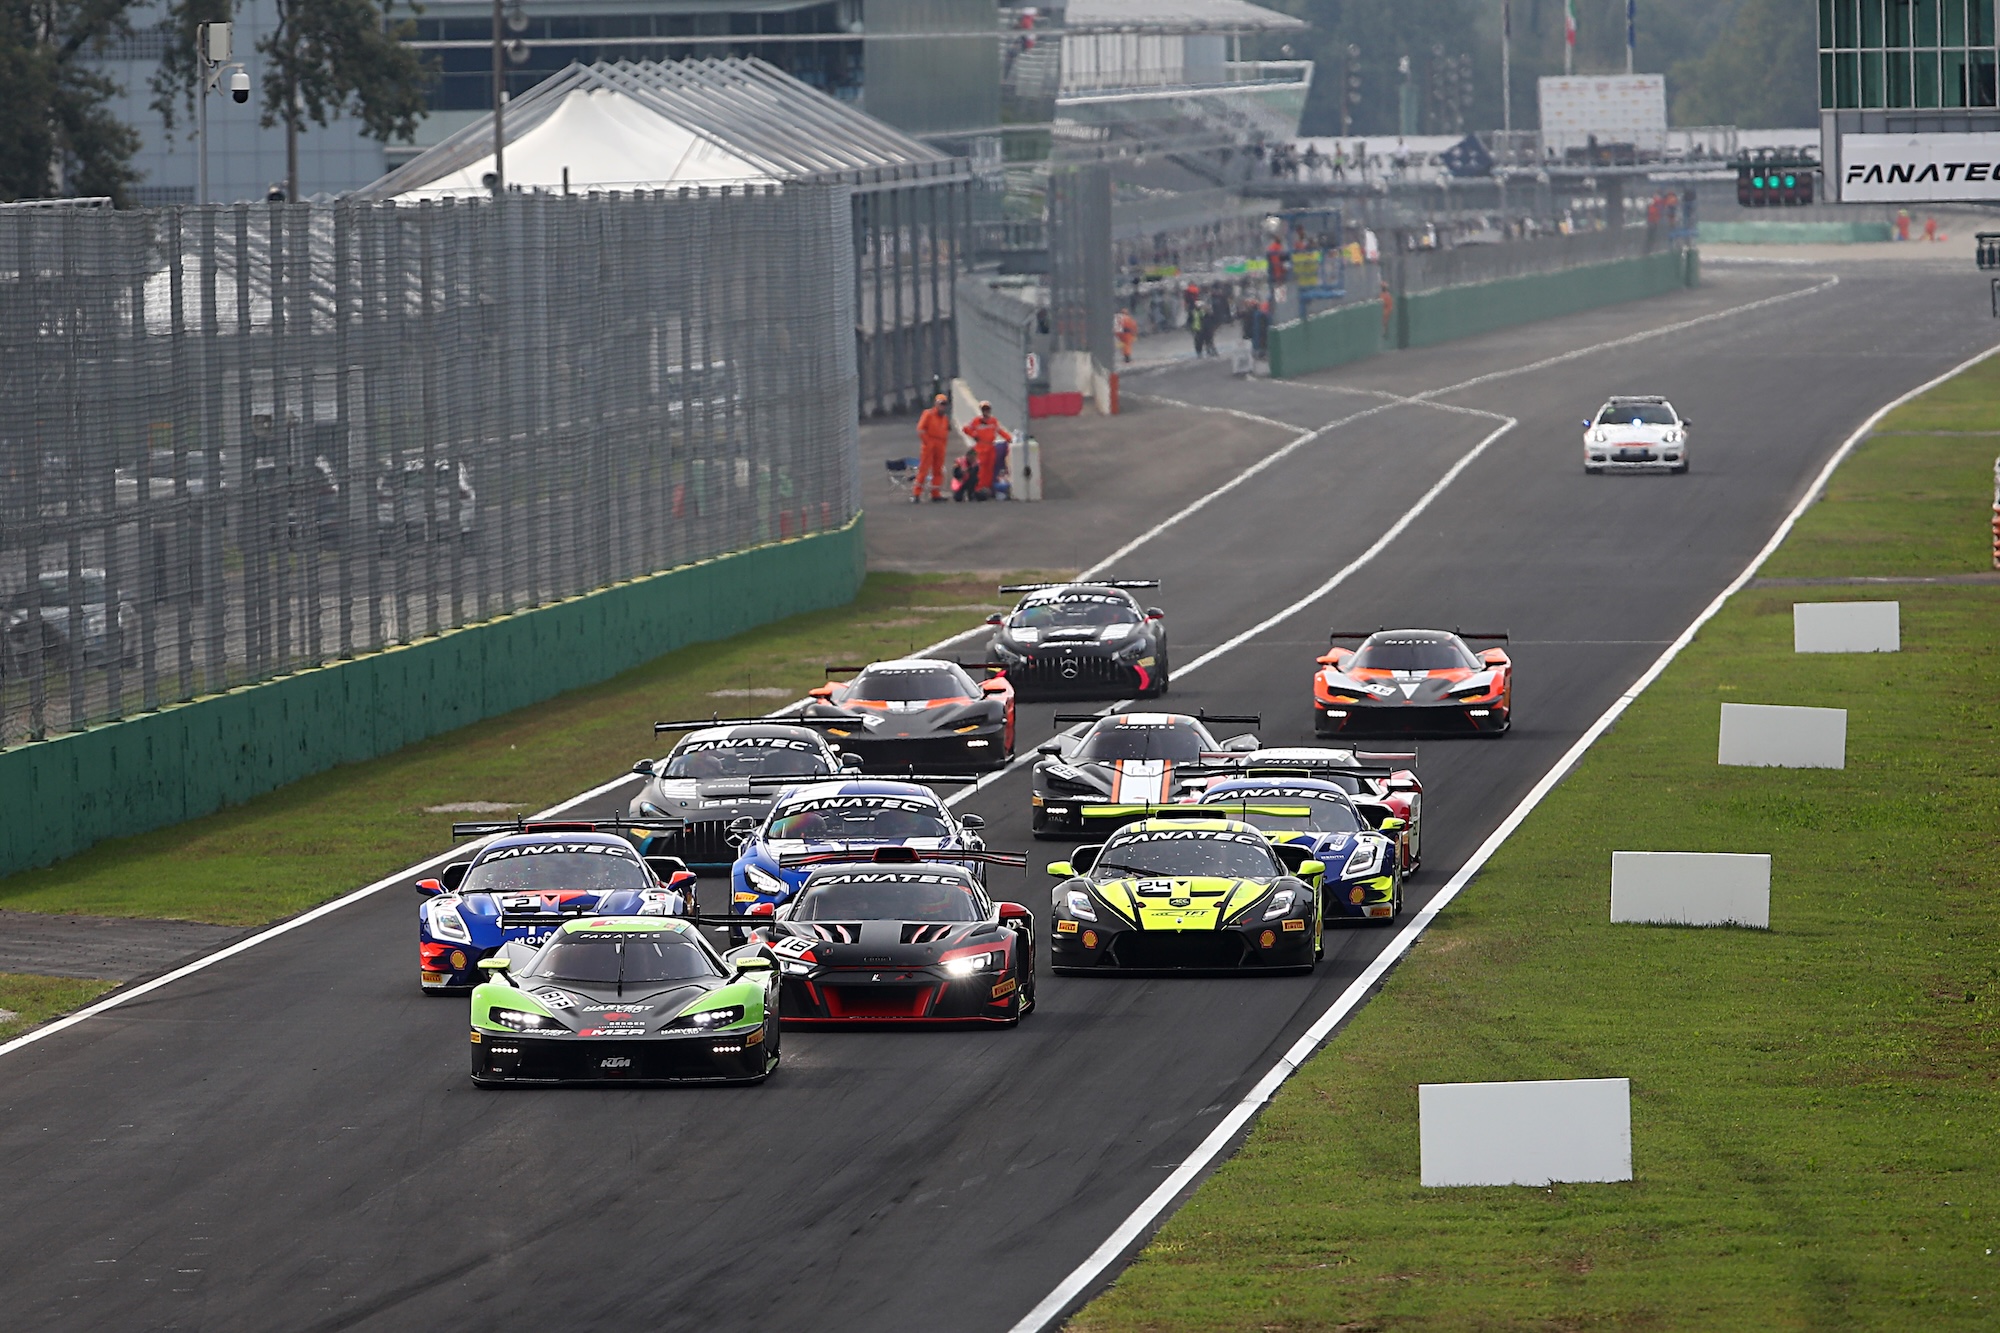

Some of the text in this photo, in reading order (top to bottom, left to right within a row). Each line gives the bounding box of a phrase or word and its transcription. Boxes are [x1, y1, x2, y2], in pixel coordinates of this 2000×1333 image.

[1023, 594, 1119, 609] FANATEC
[682, 738, 807, 755] FANATEC
[1203, 788, 1340, 804] FANATEC
[784, 798, 921, 816] FANATEC
[1111, 831, 1256, 848] FANATEC
[482, 844, 627, 863] FANATEC
[810, 874, 961, 887] FANATEC
[1137, 881, 1171, 892] 24
[600, 1057, 631, 1067] KTM
